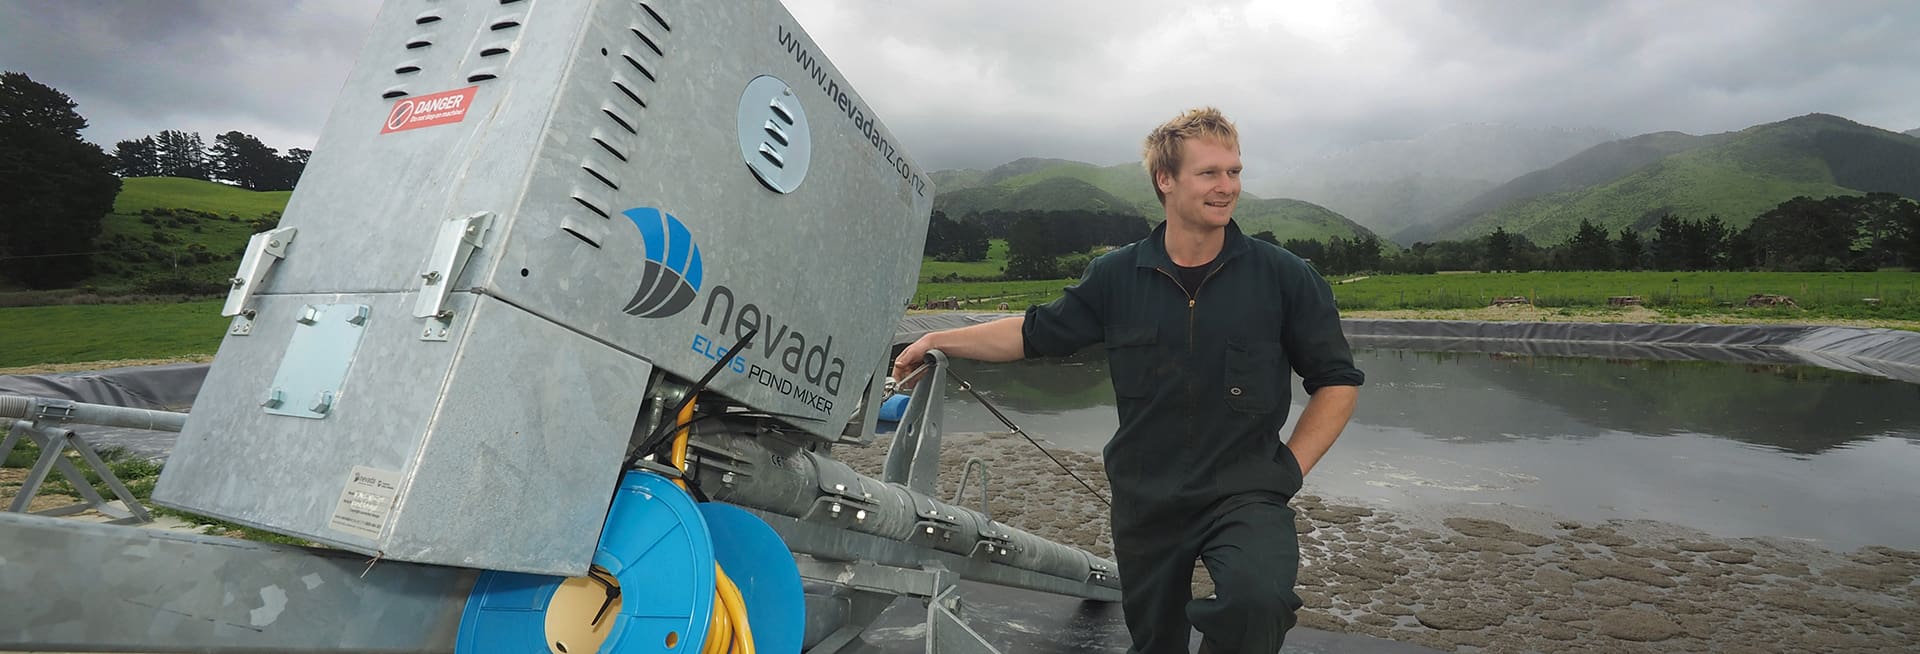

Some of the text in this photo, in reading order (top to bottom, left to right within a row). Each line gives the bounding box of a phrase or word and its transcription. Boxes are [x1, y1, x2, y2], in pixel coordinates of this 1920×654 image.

[414, 95, 464, 115] DANGER
[778, 24, 926, 197] www.nevadanz.co.nz
[701, 285, 845, 397] nevada
[748, 364, 793, 396] POND
[793, 385, 833, 416] MIXER
